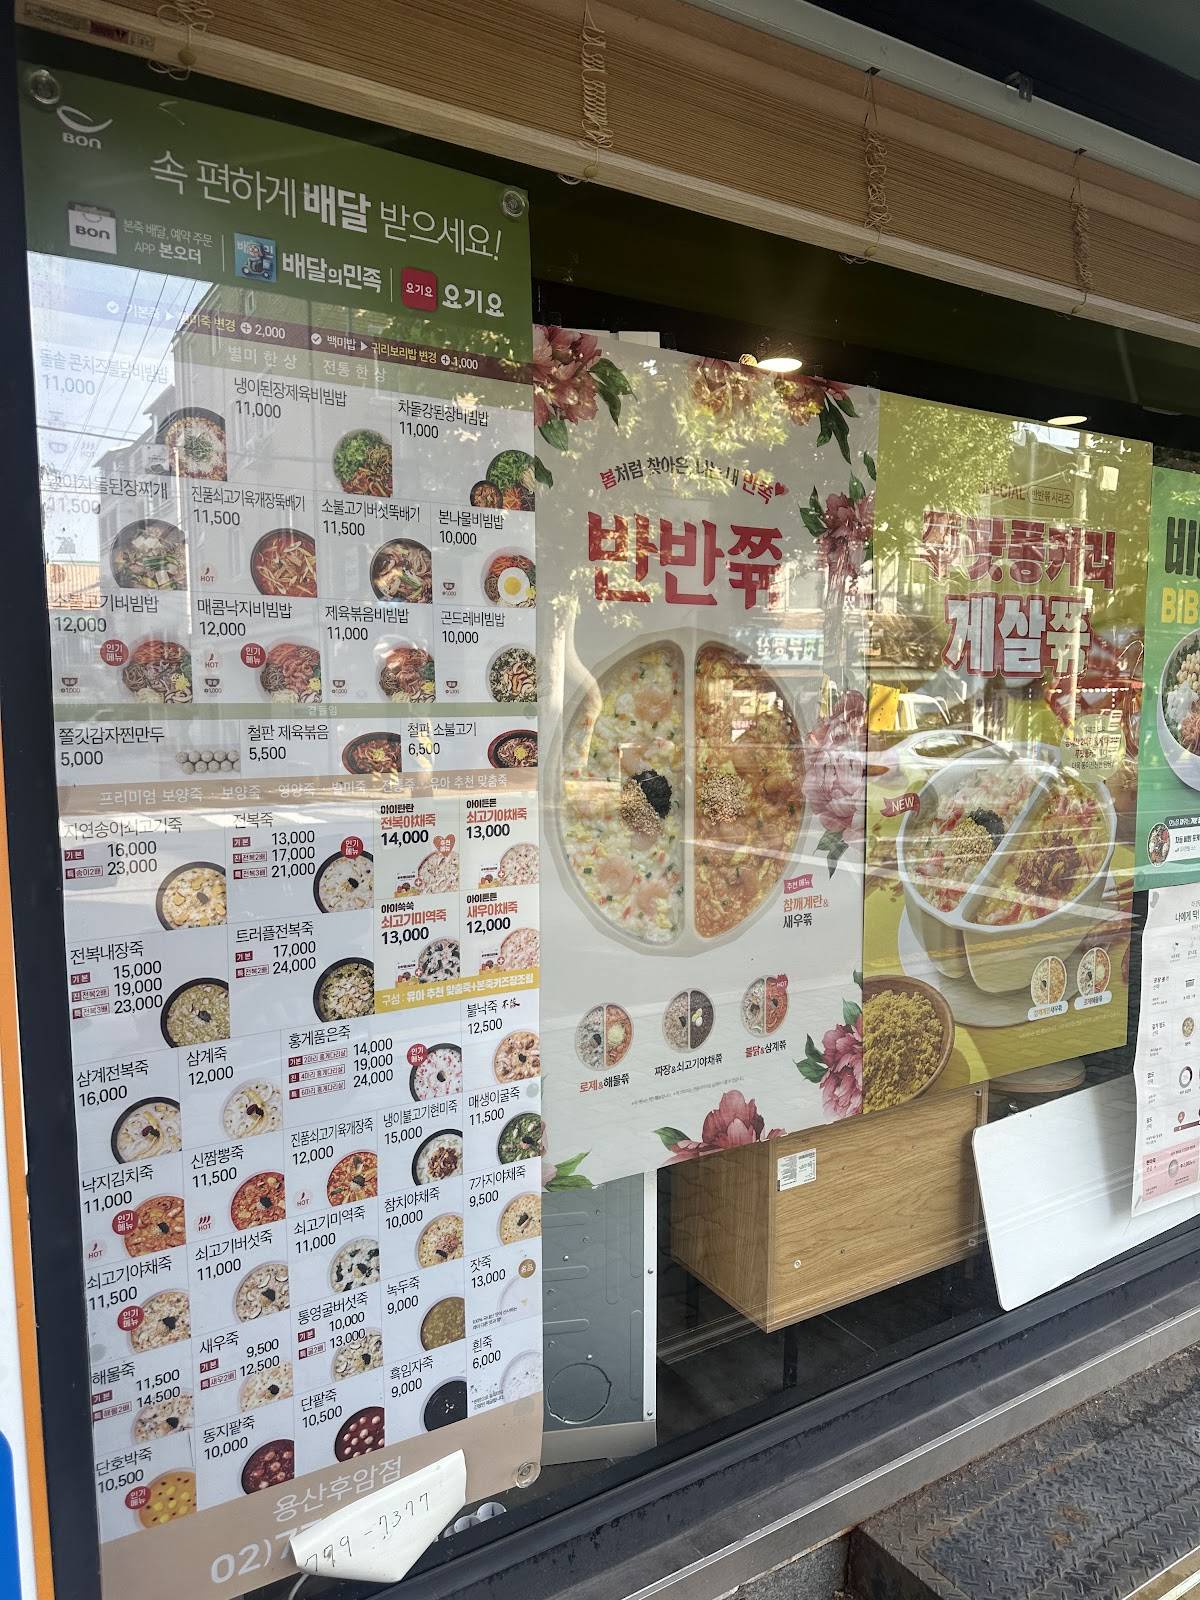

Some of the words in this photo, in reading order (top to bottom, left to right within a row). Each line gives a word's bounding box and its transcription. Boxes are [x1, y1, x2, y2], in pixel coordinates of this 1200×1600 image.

[62, 133, 102, 150] BON
[150, 150, 189, 195] 속
[197, 160, 297, 218] 편하게
[303, 182, 371, 233] 배달
[380, 201, 502, 261] 받으세요!
[75, 225, 111, 240] BON
[123, 219, 145, 233] 본죽
[192, 233, 214, 248] 주문
[134, 241, 156, 254] APP
[159, 242, 203, 264] 본오더
[282, 251, 382, 294] 배달의민족
[405, 282, 433, 298] 요기요
[442, 284, 505, 317] 요기요
[214, 316, 236, 332] 변경
[255, 322, 285, 339] 2,000
[326, 335, 356, 352] 백미밥
[371, 341, 417, 362] 귀리보리밥
[419, 349, 437, 364] 변경
[323, 358, 350, 377] 전통
[233, 377, 348, 408] 냉이된장제육비빔밥
[234, 401, 281, 420] 11,000
[397, 400, 490, 428] 차돌강된장비빔밥
[399, 421, 440, 440] 11,000
[600, 460, 644, 491] 봄처럼
[726, 466, 740, 487] 내
[191, 485, 305, 513] 진품쇠고기육개장뚝배기
[1052, 492, 1072, 504] 시리즈
[193, 508, 241, 527] 11,500
[321, 498, 421, 524] 소불고기버섯뚝배기
[439, 509, 504, 531] 본나물비빔밥
[323, 519, 366, 538] 11,500
[440, 529, 477, 546] 10,000
[197, 599, 293, 620] 매콤낙지비빔밥
[325, 605, 410, 624] 제육볶음비빔밥
[441, 610, 505, 628] 곤드레비빔밥
[54, 616, 107, 633] 12,000
[199, 621, 246, 637] 12,000
[327, 626, 369, 641] 11,000
[443, 630, 479, 645] 10,000
[59, 727, 165, 746] 쫄깃감자찐만두
[247, 724, 275, 742] 철판
[278, 723, 329, 741] 제육볶음
[433, 721, 478, 738] 소불고기
[61, 751, 104, 767] 5,000
[249, 746, 287, 762] 5,500
[408, 742, 441, 757] 6,500
[430, 777, 451, 790] 유아
[454, 775, 475, 790] 추천
[478, 773, 509, 790] 맞춤죽
[100, 789, 156, 807] 프리미엄
[163, 787, 204, 803] 보양죽
[222, 784, 261, 801] 보양죽
[891, 796, 915, 813] NEW
[233, 811, 274, 829] 전복죽
[381, 813, 437, 831] 전복야채죽
[467, 807, 527, 824] 쇠고기야채죽
[65, 816, 182, 841] 자연송이쇠고기죽
[272, 830, 315, 847] 13,000
[381, 829, 429, 848] 14,000
[466, 823, 511, 841] 13,000
[107, 840, 158, 858] 16,000
[272, 846, 316, 863] 17,000
[107, 858, 158, 877] 23,000
[271, 862, 316, 879] 21,000
[381, 901, 415, 914] 아이쑥쑥
[467, 901, 519, 919] 새우야채죽
[381, 908, 447, 929] 쇠고기미역죽
[466, 917, 511, 936] 12,000
[236, 920, 315, 943] 트러플전복죽
[382, 926, 430, 945] 13,000
[70, 940, 145, 966] 전복내장죽
[273, 940, 317, 958] 17,000
[113, 960, 162, 980] 15,000
[272, 956, 317, 975] 24,000
[114, 977, 163, 997] 19,000
[776, 981, 788, 989] HOT
[114, 994, 164, 1015] 23,000
[467, 1000, 499, 1019] 불낙죽
[289, 1024, 351, 1049] 홍게품은죽
[468, 1018, 503, 1035] 12,500
[186, 1045, 228, 1067] 삼계죽
[353, 1038, 393, 1056] 14,000
[353, 1053, 394, 1072] 19,000
[77, 1059, 149, 1088] 삼계전복죽
[188, 1066, 234, 1087] 12,000
[353, 1069, 394, 1088] 24,000
[78, 1085, 128, 1107] 16,000
[468, 1085, 521, 1109] 매생이굴죽
[383, 1099, 458, 1129] 냉이불고기현미죽
[469, 1107, 505, 1126] 11,500
[290, 1117, 375, 1148] 진품쇠고기육개장죽
[384, 1126, 423, 1145] 15,000
[191, 1144, 245, 1170] 신짬뽕죽
[292, 1145, 334, 1166] 12,000
[82, 1163, 155, 1194] 낙지김치죽
[192, 1166, 238, 1188] 11,500
[468, 1164, 528, 1191] 7가지야채죽
[84, 1190, 133, 1214] 11,000
[384, 1186, 441, 1213] 참치야채죽
[469, 1189, 500, 1208] 9,500
[198, 1223, 213, 1231] HOT
[293, 1205, 366, 1235] 쇠고기미역죽
[385, 1209, 424, 1230] 10,000
[195, 1228, 274, 1261] 쇠고기버섯죽
[295, 1232, 337, 1254] 11,000
[88, 1250, 103, 1259] HOT
[470, 1254, 492, 1274] 잣죽
[87, 1255, 173, 1290] 쇠고기야채죽
[196, 1258, 242, 1281] 11,000
[470, 1268, 506, 1289] 13,000
[387, 1275, 421, 1297] 녹두죽
[88, 1286, 138, 1311] 11,500
[298, 1291, 369, 1326] 통영굴버섯죽
[386, 1295, 419, 1315] 9,000
[329, 1311, 366, 1332] 10,000
[199, 1331, 240, 1355] 새우죽
[246, 1338, 280, 1358] 9,500
[329, 1328, 367, 1349] 13,000
[472, 1334, 493, 1354] 흰죽
[239, 1354, 280, 1377] 12,500
[390, 1355, 433, 1381] 흑임자죽
[472, 1350, 502, 1370] 6,000
[91, 1361, 137, 1387] 해물죽
[135, 1368, 181, 1392] 11,500
[136, 1386, 181, 1409] 14,500
[391, 1377, 422, 1398] 9,000
[301, 1388, 337, 1412] 단팥죽
[302, 1405, 343, 1429] 10,500
[202, 1415, 256, 1444] 동지팥죽
[204, 1436, 249, 1460] 10,000
[96, 1446, 153, 1477] 단호박죽
[97, 1468, 145, 1494] 10,500
[273, 1456, 403, 1523] 용산후암점
